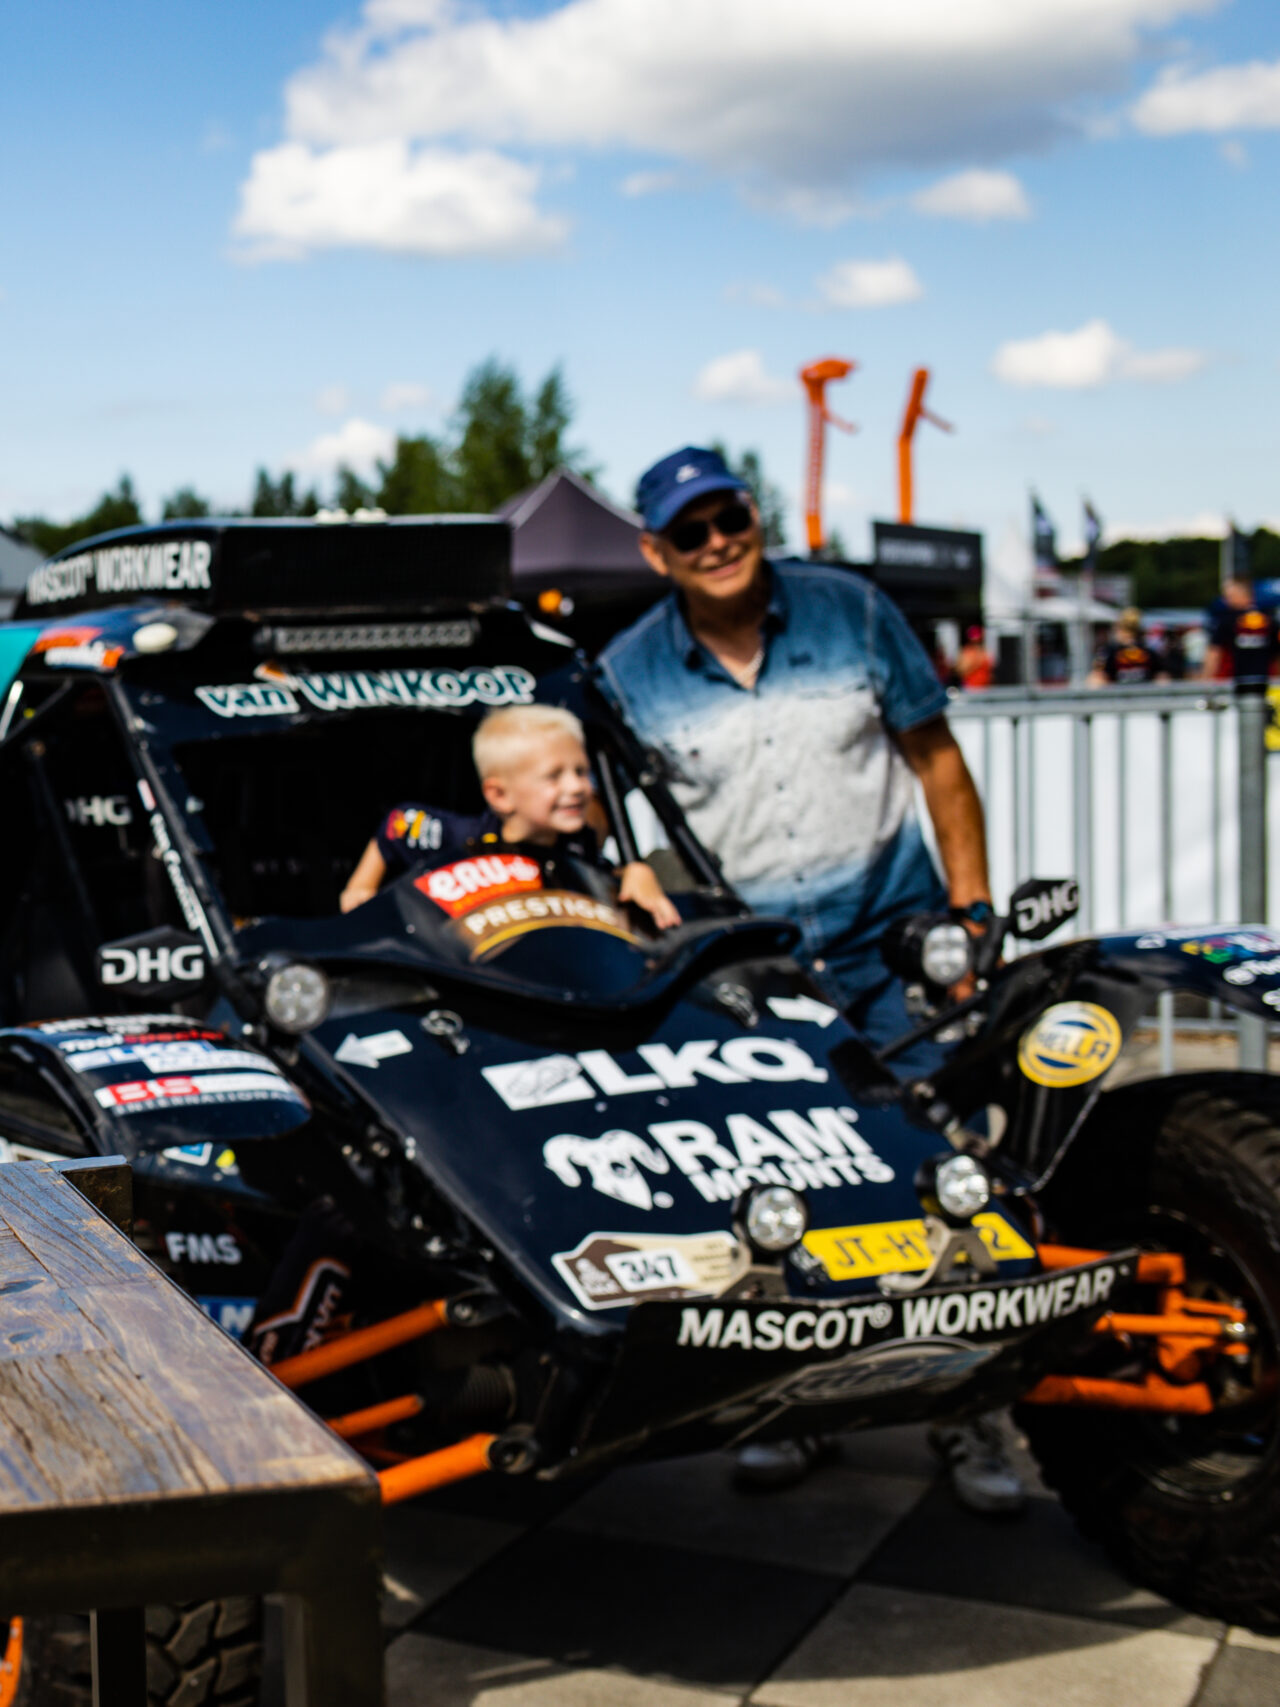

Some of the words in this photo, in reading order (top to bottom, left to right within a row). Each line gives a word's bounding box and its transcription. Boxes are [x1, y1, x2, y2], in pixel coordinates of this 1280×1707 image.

[94, 541, 212, 592] WORKWEAR
[297, 666, 537, 711] WINKOOP
[464, 896, 618, 935] PRESTIGE
[101, 945, 205, 983] DHG
[577, 1036, 829, 1096] LKQ
[648, 1106, 874, 1175] RAM
[165, 1232, 242, 1265] FMS
[621, 1255, 678, 1284] 347
[902, 1266, 1117, 1339] WORKWEAR
